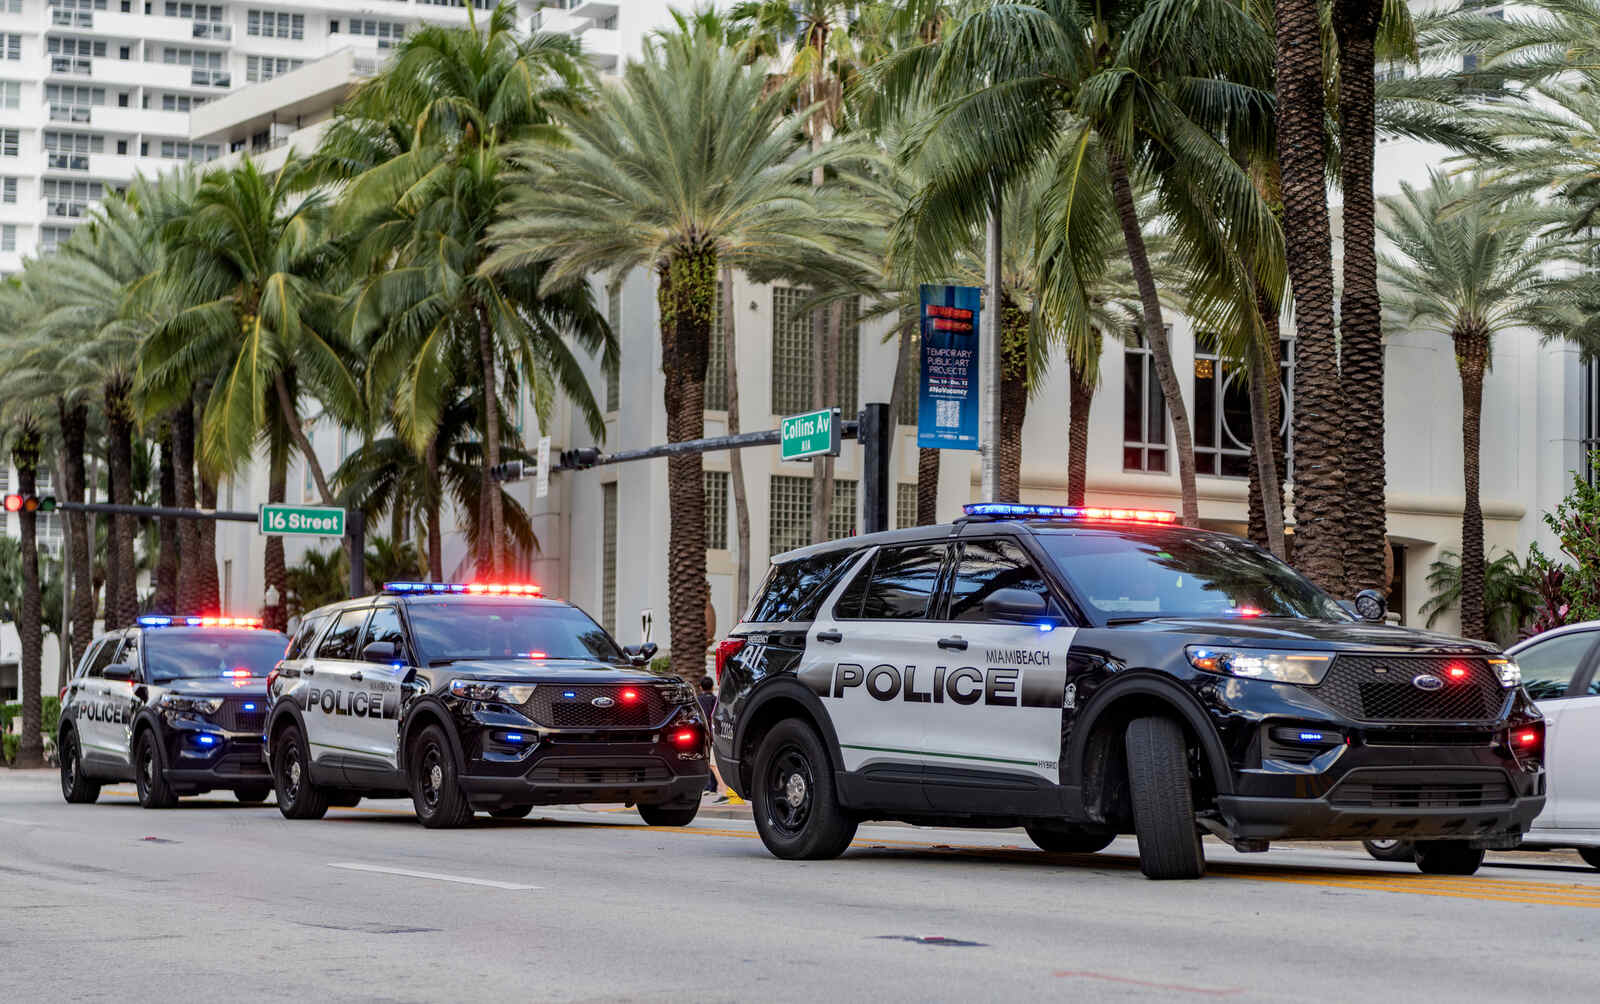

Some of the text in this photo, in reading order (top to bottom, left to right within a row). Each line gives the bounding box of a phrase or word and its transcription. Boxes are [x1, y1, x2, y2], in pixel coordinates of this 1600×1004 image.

[927, 347, 972, 358] TEMPORARY
[928, 357, 969, 367] PUBLIC ART
[928, 366, 967, 376] PROJECTS
[929, 386, 968, 396] #NoVacancy
[783, 415, 829, 440] Collins Av
[268, 511, 338, 530] 16 Street
[740, 645, 767, 669] 911
[833, 663, 1020, 707] POLICE
[79, 701, 121, 723] POLICE
[306, 687, 384, 719] POLICE
